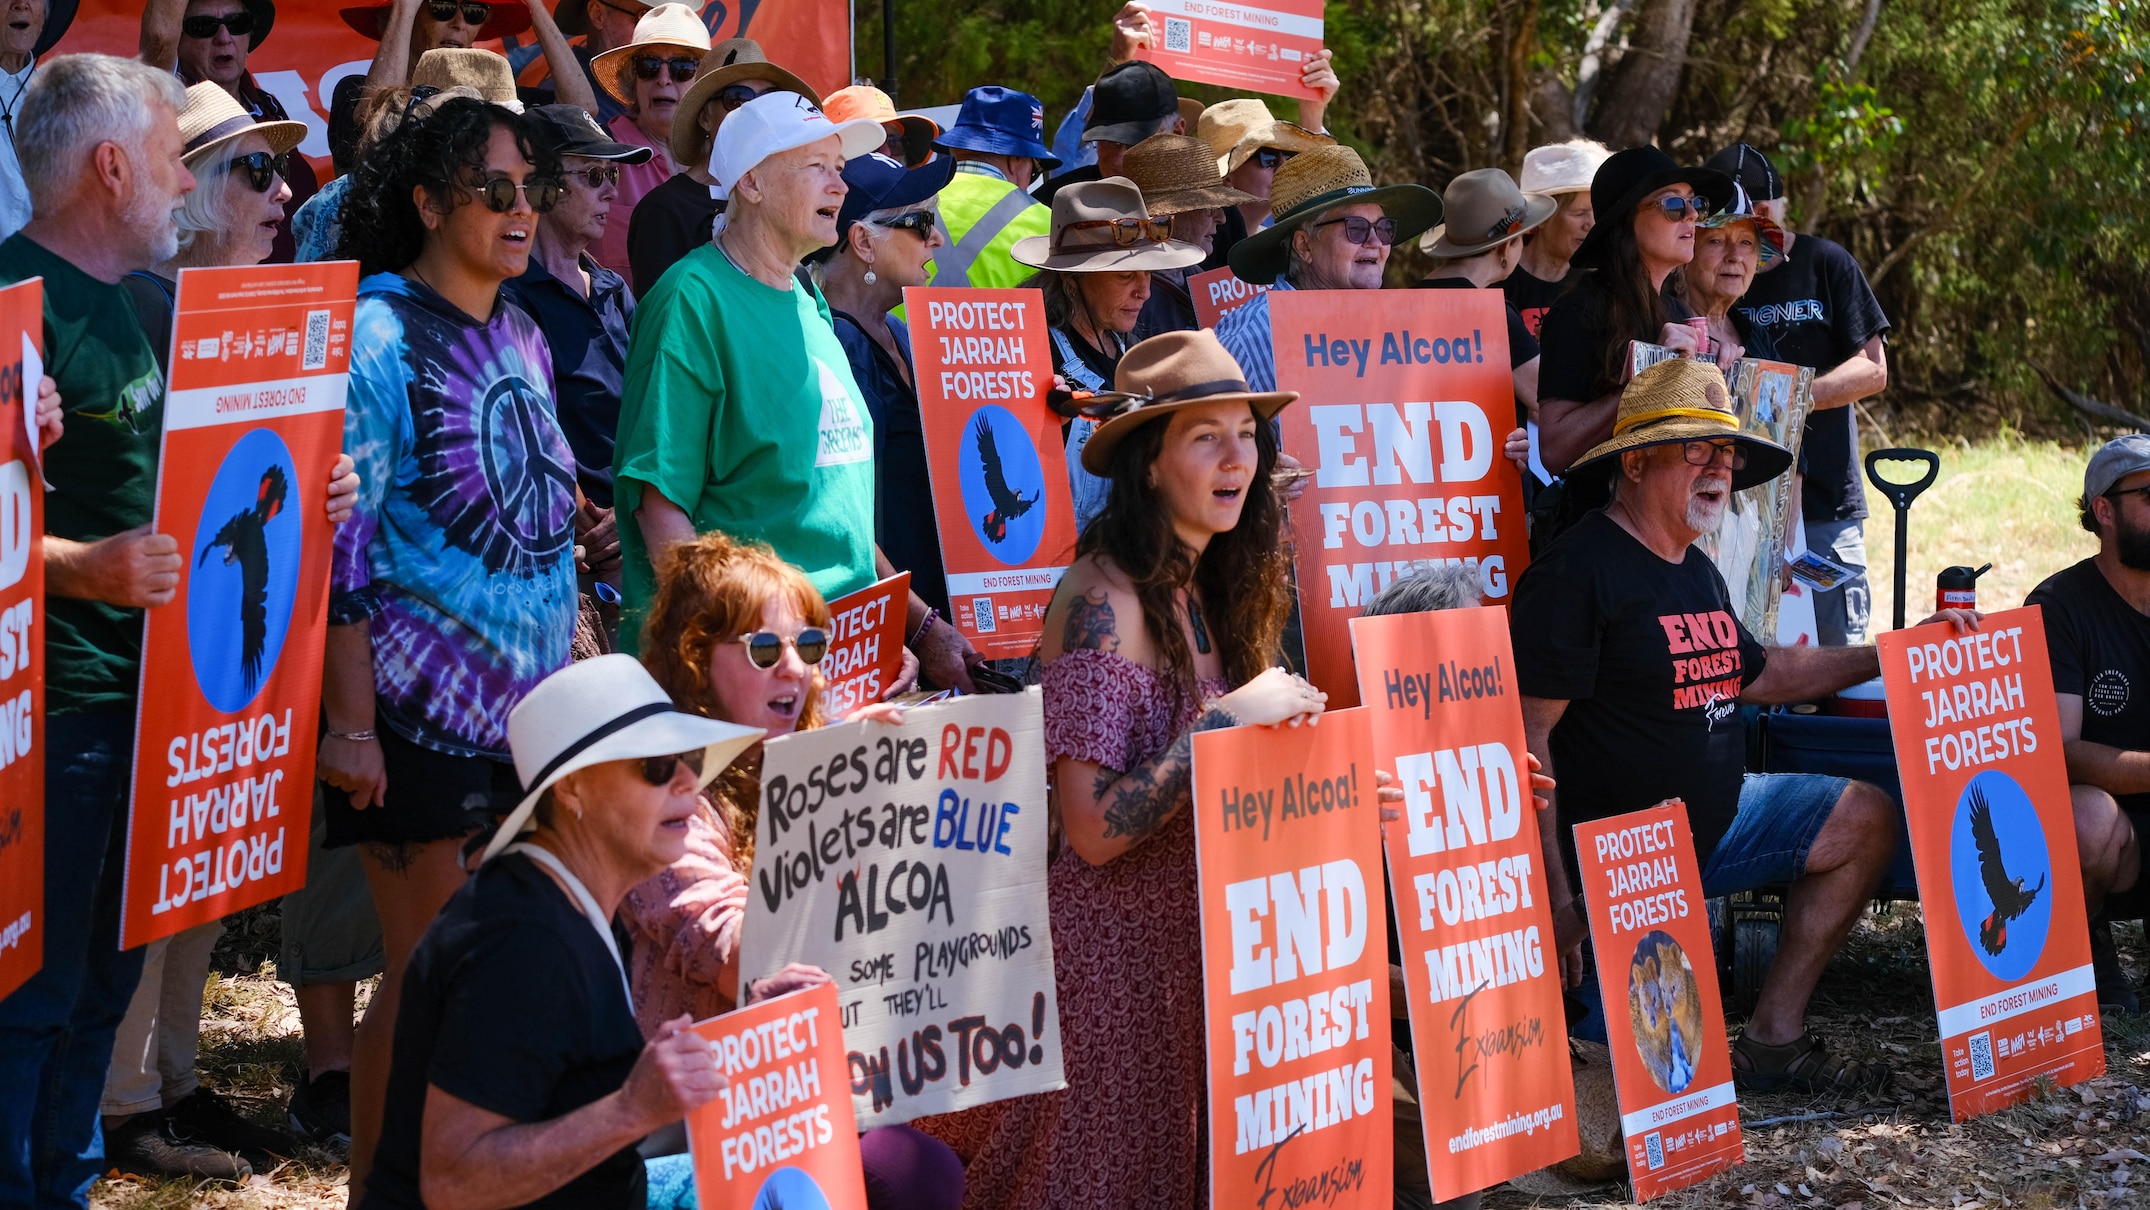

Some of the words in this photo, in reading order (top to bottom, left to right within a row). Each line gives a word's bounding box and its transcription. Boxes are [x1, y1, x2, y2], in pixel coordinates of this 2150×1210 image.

[1184, 1, 1204, 14] END
[1205, 6, 1241, 20] FOREST
[1243, 12, 1279, 27] MINING
[928, 301, 1026, 330] PROTECT
[939, 336, 1026, 365] JARRAH
[1304, 332, 1371, 378] Hey
[1380, 329, 1484, 366] Alcoa!
[216, 395, 251, 413] MINING
[252, 389, 287, 409] FOREST
[289, 386, 306, 404] END
[940, 371, 1036, 400] FORESTS
[1309, 401, 1494, 489] END
[1319, 495, 1501, 550] FOREST
[983, 577, 998, 588] END
[998, 575, 1025, 587] FOREST
[1025, 573, 1052, 585] MINING
[820, 633, 880, 682] RRAH
[1658, 609, 1738, 655] END
[1906, 626, 2022, 684] PROTECT
[1384, 668, 1431, 720] Hey
[1439, 655, 1504, 703] Alcoa!
[1672, 648, 1742, 684] FOREST
[1673, 675, 1742, 710] MINING
[1921, 673, 2025, 728] JARRAH
[166, 708, 292, 788] FORESTS
[1925, 716, 2037, 775] FORESTS
[167, 769, 284, 849] JARRAH
[766, 745, 868, 847] Roses
[874, 736, 928, 786] are
[938, 723, 1013, 784] RED
[1221, 786, 1274, 841] Hey
[1281, 763, 1358, 821] Alcoa!
[1395, 742, 1521, 858] END
[879, 802, 930, 849] are
[933, 788, 1021, 856] BLUE
[1595, 819, 1675, 863] PROTECT
[152, 826, 285, 915] PROTECT
[1413, 853, 1533, 931] FOREST
[1606, 855, 1679, 898] JARRAH
[834, 859, 955, 943] ALCOA
[1225, 858, 1368, 996] END
[1609, 889, 1689, 934] FORESTS
[850, 953, 895, 987] SOME
[913, 926, 1033, 983] PLAYGROUNDS
[1424, 925, 1544, 1004] MINING
[839, 1001, 863, 1029] UT
[884, 983, 949, 1018] THEY'LL
[1232, 978, 1372, 1077] FOREST
[1980, 1005, 1998, 1019] END
[1998, 993, 2028, 1014] FOREST
[2028, 983, 2058, 1003] MINING
[898, 1024, 947, 1096] US
[947, 991, 1046, 1087] TOO!
[1450, 979, 1545, 1100] Expansion
[719, 1057, 821, 1129] JARRAH
[1234, 1058, 1374, 1156] MINING
[1652, 1110, 1665, 1122] END
[1665, 1102, 1688, 1119] FOREST
[1687, 1095, 1709, 1111] MINING
[721, 1104, 833, 1181] FORESTS
[1448, 1102, 1563, 1154] endforestmining.org.au
